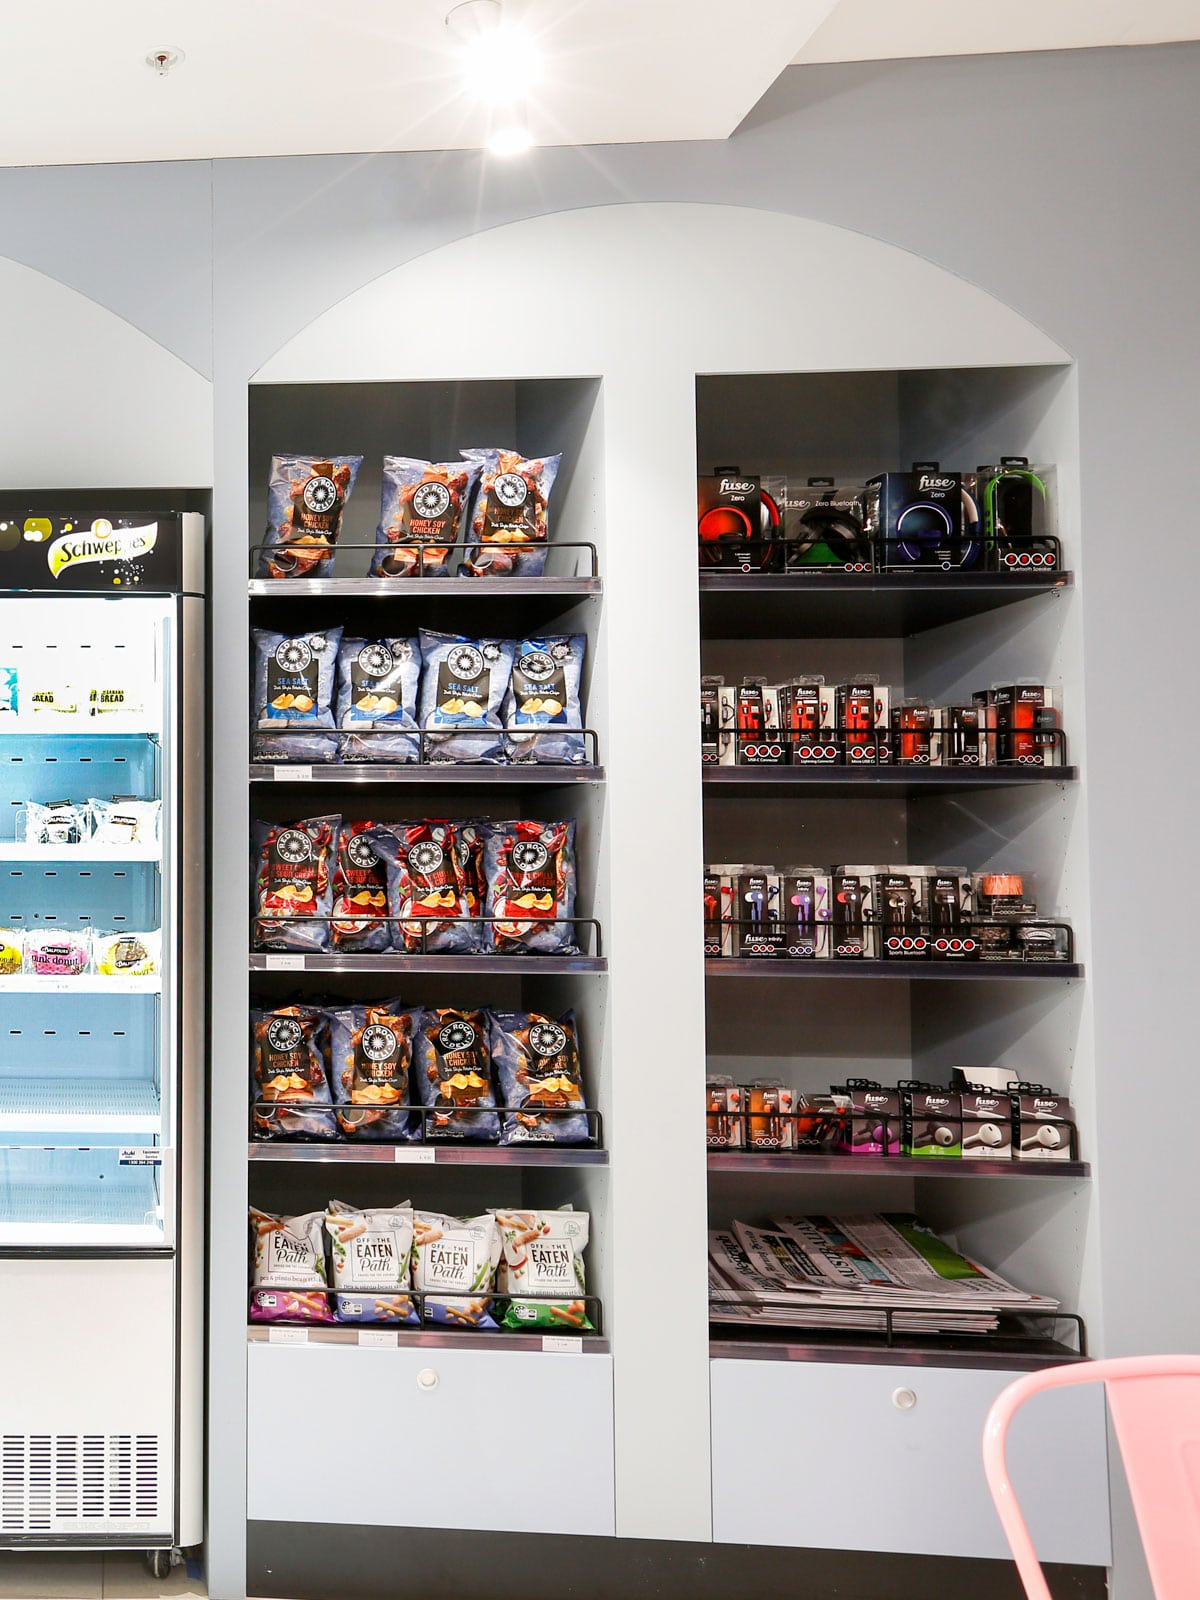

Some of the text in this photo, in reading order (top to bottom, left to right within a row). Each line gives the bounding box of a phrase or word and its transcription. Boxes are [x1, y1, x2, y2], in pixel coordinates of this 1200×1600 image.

[306, 479, 335, 502] RED ROCK
[506, 475, 526, 496] ROCK
[719, 479, 755, 495] fuse
[919, 475, 956, 492] fuse
[415, 485, 448, 505] RED ROCK
[310, 501, 330, 511] DELI
[419, 506, 441, 517] DELI
[410, 519, 446, 528] HONEY SOY
[412, 527, 441, 535] CHICKEN
[60, 536, 146, 562] Schwepes
[279, 639, 310, 660] RED ROCK
[361, 646, 391, 665] RED ROCK
[283, 663, 306, 671] DELI
[450, 649, 481, 671] RED ROCK
[534, 654, 553, 670] ROCK
[367, 666, 389, 675] DELI
[453, 669, 477, 678] DELI
[462, 685, 480, 693] SALT
[1021, 690, 1041, 698] fuse
[279, 831, 309, 850] RED ROCK
[351, 839, 360, 854] RED
[284, 852, 304, 861] DELI
[421, 844, 441, 860] ROCK
[516, 844, 545, 860] RED ROCK
[745, 935, 767, 944] fuse
[52, 955, 78, 966] donut
[271, 1020, 300, 1039] RED ROCK
[442, 1024, 473, 1043] RED ROCK
[532, 1025, 563, 1044] RED ROCK
[364, 1028, 395, 1046] RED ROCK
[275, 1040, 295, 1050] DELI
[448, 1040, 472, 1049] DELI
[540, 1044, 562, 1055] DELI
[368, 1049, 389, 1060] DELI
[383, 1062, 397, 1070] SOY
[864, 1092, 888, 1107] fuse
[925, 1096, 949, 1107] fuse
[975, 1097, 999, 1108] fuse
[1034, 1098, 1058, 1110] fuse
[276, 1250, 308, 1264] Path
[357, 1244, 393, 1258] EATEN
[431, 1250, 468, 1266] EATEN
[531, 1250, 570, 1264] EATEN
[360, 1258, 391, 1272] Path
[432, 1263, 465, 1280] Path
[536, 1263, 567, 1278] Path
